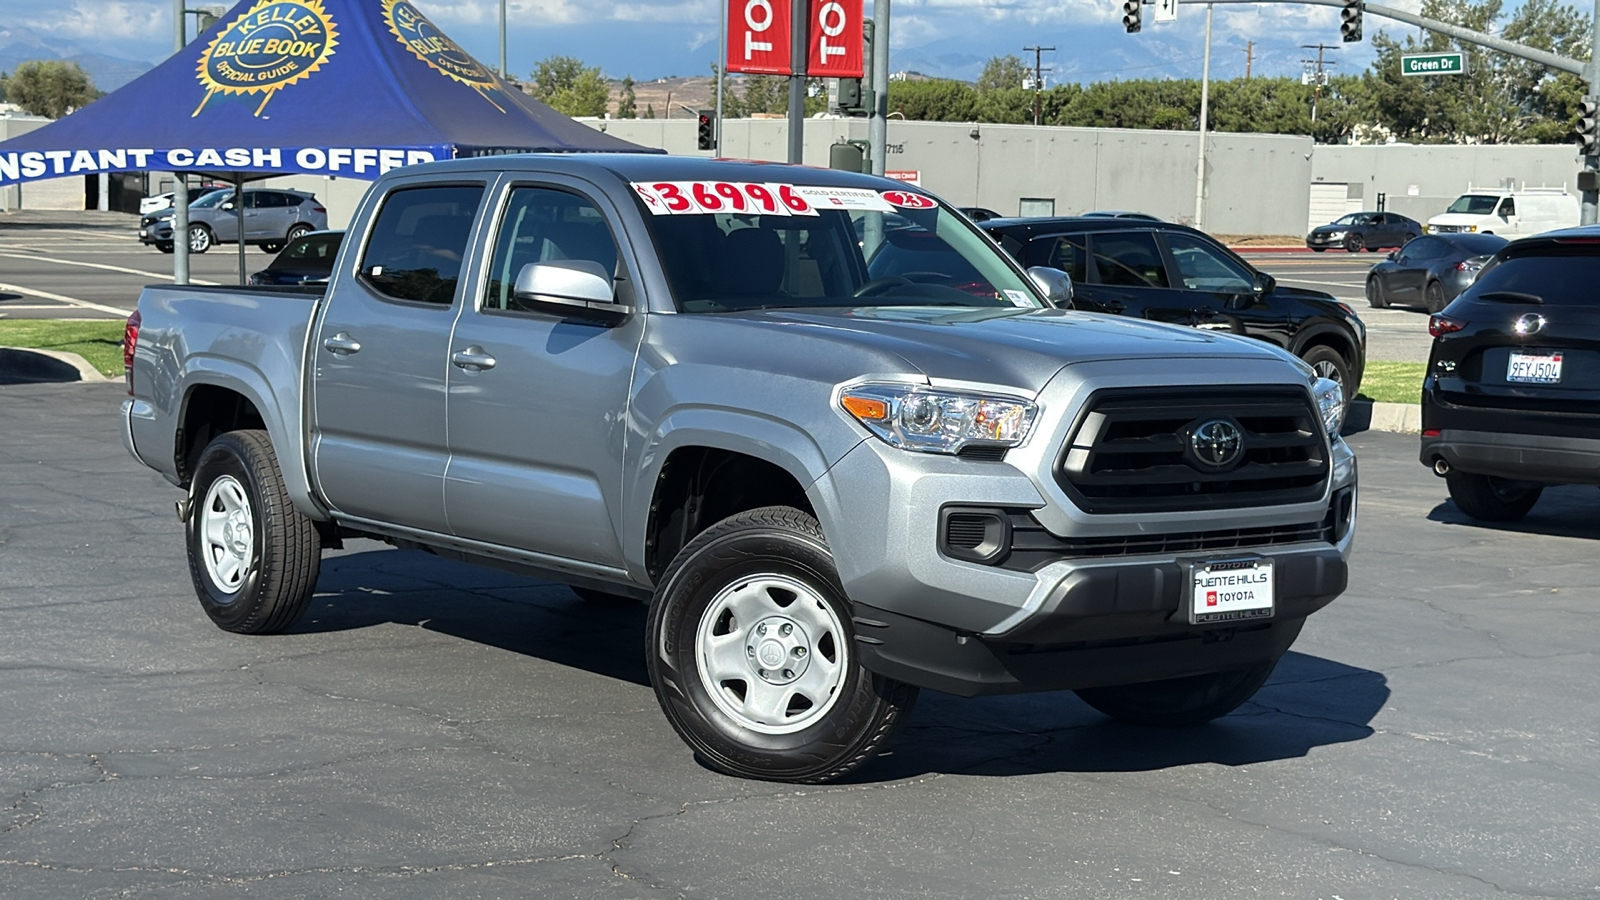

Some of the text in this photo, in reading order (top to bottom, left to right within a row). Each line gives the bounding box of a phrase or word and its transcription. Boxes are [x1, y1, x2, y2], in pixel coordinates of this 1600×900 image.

[238, 7, 321, 35] KELLEY
[819, 0, 846, 64] TO
[213, 38, 321, 58] BLUE BOOK
[216, 60, 299, 82] OFFICIAL GUIDE
[1410, 58, 1454, 71] Green Dr
[167, 148, 282, 168] CASH
[830, 190, 875, 198] CERTIFIED
[894, 192, 923, 207] 23
[1511, 362, 1557, 377] 9FYJ504
[1212, 561, 1254, 570] TOYOTA
[1194, 573, 1267, 588] PUENTE HILLS
[1219, 590, 1254, 602] TOYOTA
[1196, 609, 1270, 622] PUENTE HILLS
